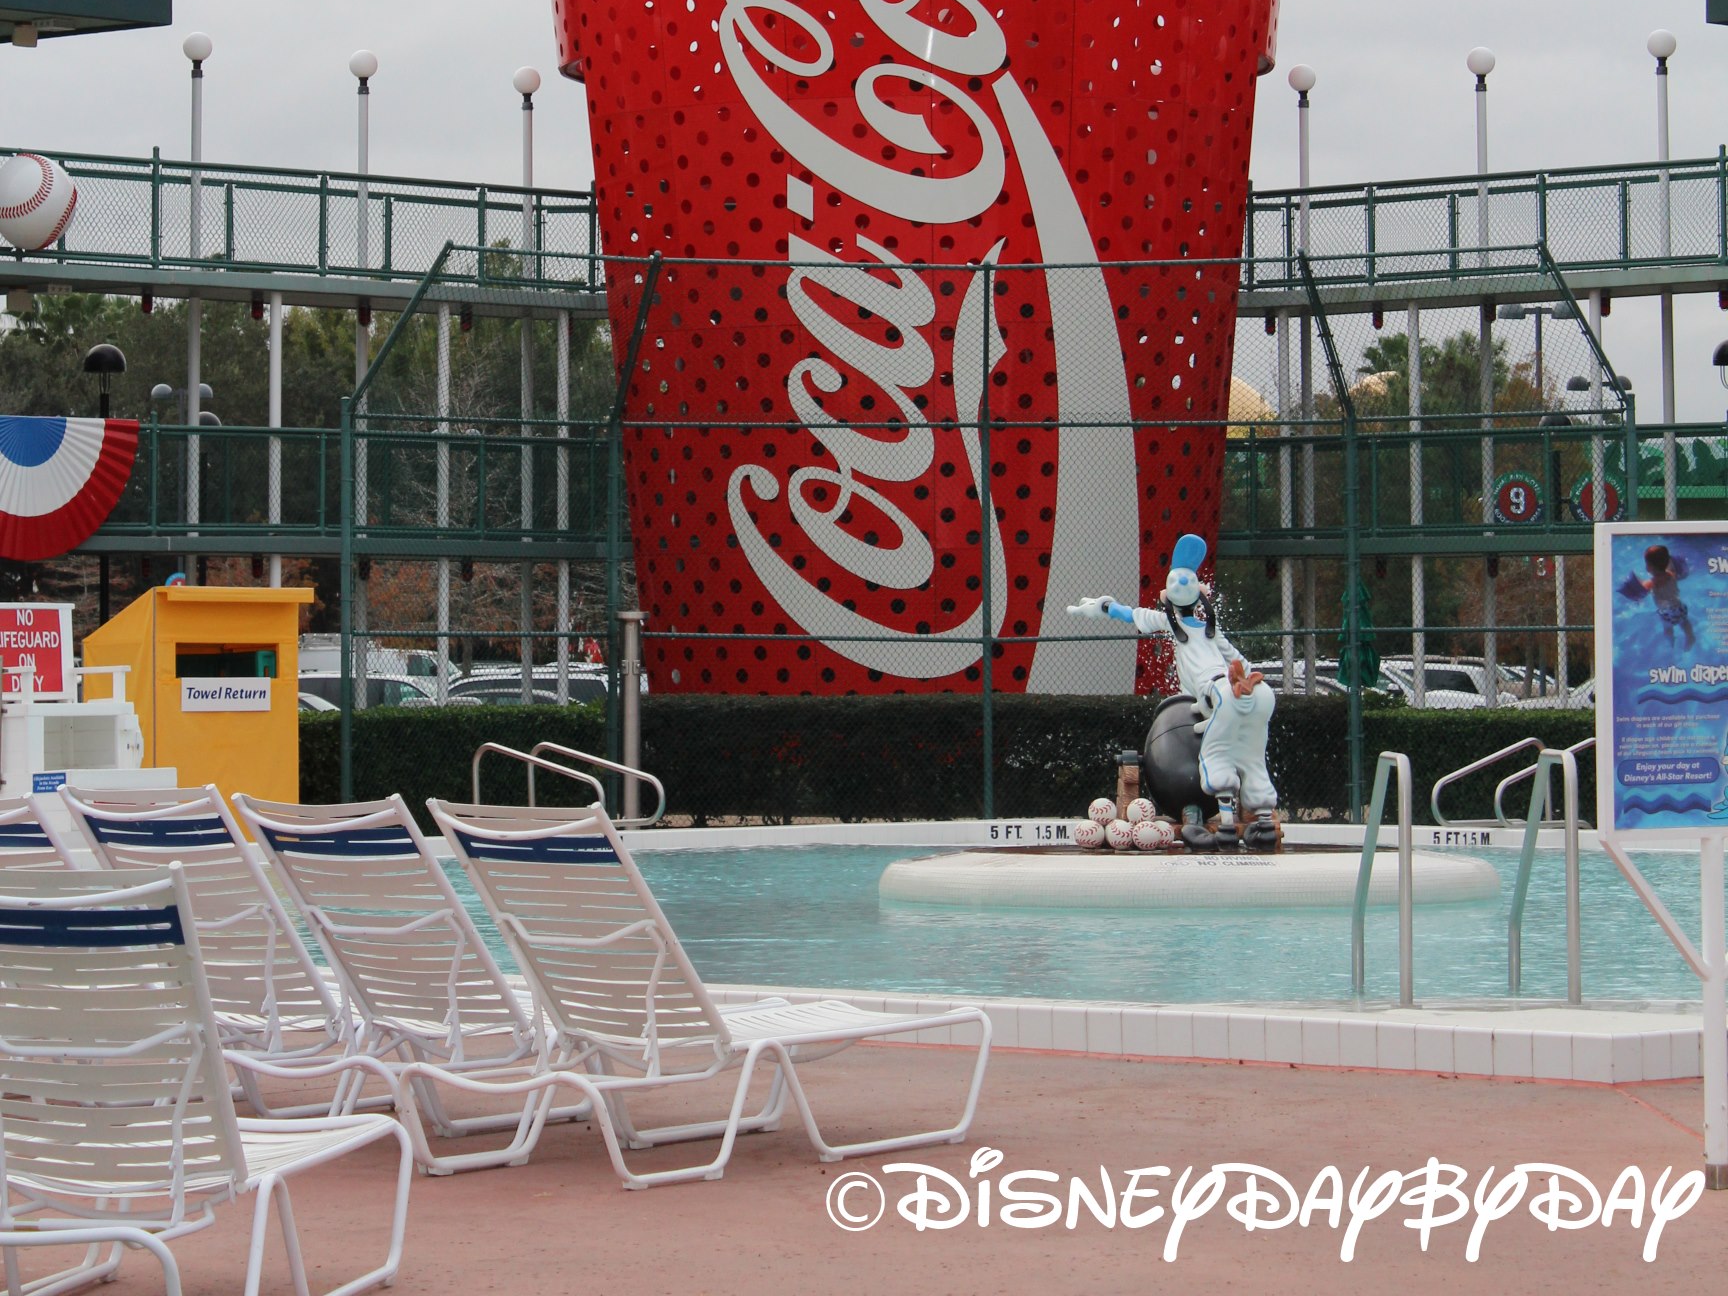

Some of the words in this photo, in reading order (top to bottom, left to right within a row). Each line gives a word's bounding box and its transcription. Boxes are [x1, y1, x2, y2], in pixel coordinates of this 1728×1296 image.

[1509, 487, 1526, 514] 9
[16, 609, 34, 626] NO
[0, 631, 60, 648] IFEGUARD
[19, 653, 36, 668] ON
[1649, 666, 1687, 683] swim
[11, 675, 44, 692] DY
[186, 687, 222, 700] Towel
[224, 687, 266, 700] Return
[1636, 762, 1656, 772] Enjoy
[1657, 763, 1675, 773] your
[1676, 762, 1690, 771] day
[1624, 774, 1655, 783] Disney's
[1656, 772, 1684, 781] All-Star
[1685, 771, 1712, 780] Resort!
[990, 825, 999, 839] 5
[1035, 825, 1052, 839] 1.5
[1056, 825, 1070, 839] M.
[1433, 831, 1440, 844] 5
